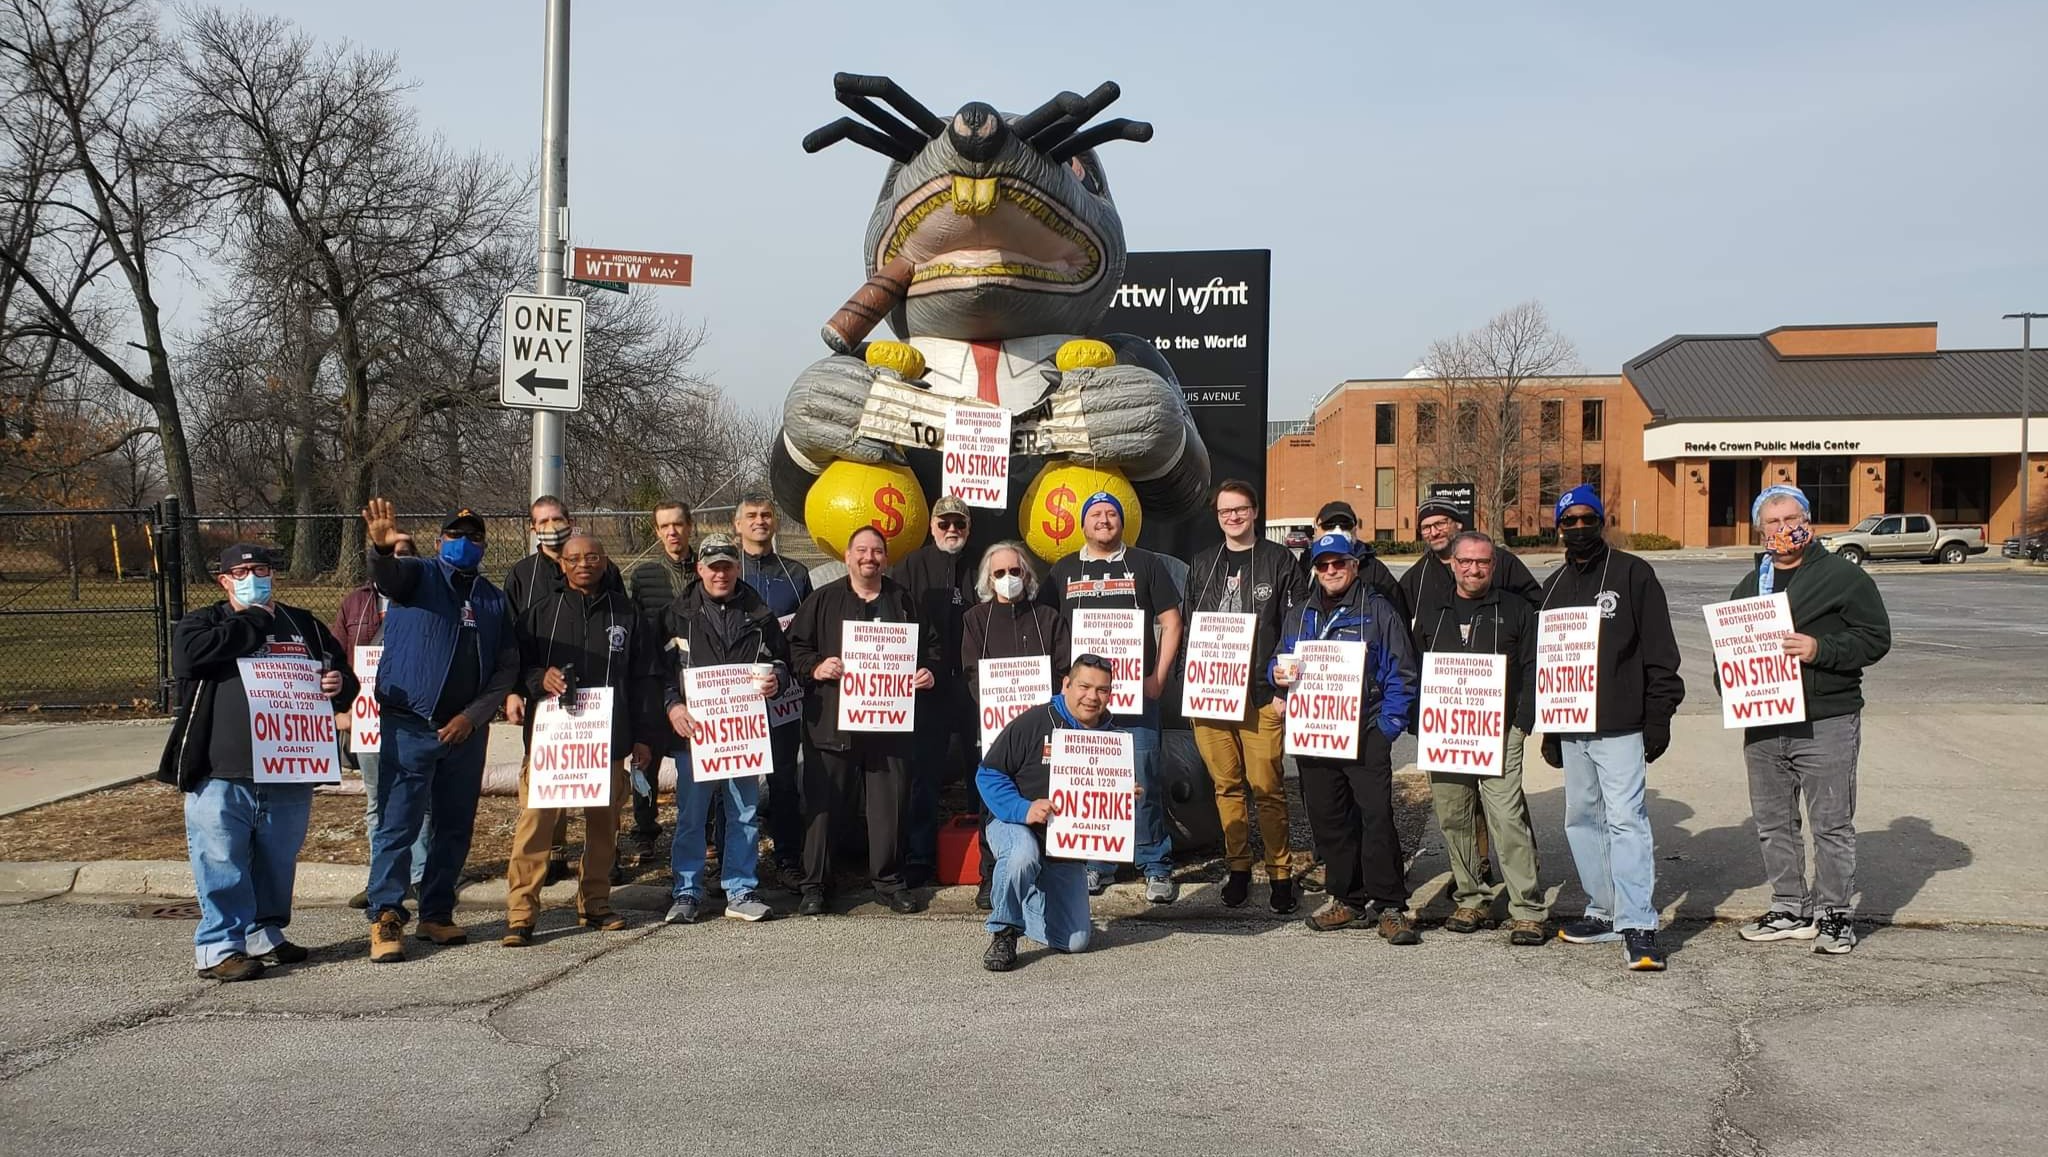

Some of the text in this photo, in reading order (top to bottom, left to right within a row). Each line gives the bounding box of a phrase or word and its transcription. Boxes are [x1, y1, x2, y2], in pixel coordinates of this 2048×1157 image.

[612, 255, 652, 264] HONORARY
[586, 261, 676, 279] WTTW WAY
[1178, 277, 1248, 315] wfmt
[515, 306, 572, 333] ONE
[1155, 335, 1247, 349] to the World
[513, 336, 572, 363] WAY
[1184, 392, 1240, 401] UIS AVENUE
[956, 411, 1002, 420] INTERNATIONAL
[956, 419, 1001, 428] BROTHERHOOD
[911, 422, 937, 446] TO
[947, 435, 1008, 445] ELECTRICAL WORKERS
[1685, 441, 1860, 450] Renée Crown Public Media Center
[959, 443, 994, 452] LOCAL 1220
[946, 452, 1007, 478] ON STRIKE
[950, 486, 1000, 501] WTTW
[1716, 600, 1775, 616] INTERNATIONAL
[1200, 616, 1246, 624] INTERNATIONAL
[1719, 610, 1776, 626] BROTHERHOOD
[854, 626, 908, 635] INTERNATIONAL
[1083, 621, 1133, 629] BROTHERHOOD
[1200, 625, 1244, 633] BROTHERHOOD
[1745, 624, 1754, 633] OF
[855, 635, 906, 643] BROTHERHOOD
[1110, 638, 1141, 646] WORKERS
[1558, 633, 1566, 641] OF
[1715, 635, 1753, 648] ELECTRICAL
[1190, 641, 1250, 651] ELECTRICAL WORKERS
[1565, 642, 1595, 651] WORKERS
[1733, 642, 1777, 655] LOCAL 1220
[845, 652, 915, 662] ELECTRICAL WORKERS
[1201, 650, 1236, 659] LOCAL 1220
[1566, 653, 1580, 661] 1220
[252, 663, 313, 672] INTERNATIONAL
[990, 661, 1040, 670] INTERNATIONAL
[1435, 658, 1493, 668] INTERNATIONAL
[256, 672, 314, 681] BROTHERHOOD
[696, 668, 750, 679] INTERNATIONAL
[990, 669, 1040, 678] BROTHERHOOD
[1188, 660, 1247, 686] ON STRIKE
[1435, 667, 1492, 677] BROTHERHOOD
[1722, 654, 1798, 688] ON STRIKE
[697, 677, 751, 688] BROTHERHOOD
[1326, 673, 1359, 682] WORKERS
[1538, 665, 1594, 694] ON STRIKE
[844, 672, 913, 697] ON STRIKE
[982, 684, 1050, 695] ELECTRICAL WORKERS
[1304, 682, 1343, 691] LOCAL 1220
[250, 690, 290, 699] ELECTRICAL
[1424, 686, 1502, 697] ELECTRICAL WORKERS
[1745, 687, 1780, 697] AGAINST
[269, 700, 314, 710] LOCAL 1220
[690, 694, 763, 708] ELECTRICAL WORKERS
[1190, 696, 1239, 713] WTTW
[1439, 696, 1484, 706] LOCAL 1220
[706, 704, 748, 716] LOCAL 1220
[1289, 694, 1358, 721] ON STRIKE
[1732, 698, 1795, 719] WTTW
[848, 709, 906, 724] WTTW
[984, 706, 1005, 730] ON
[1541, 708, 1588, 724] WTTW
[255, 712, 280, 741] ON
[284, 713, 334, 742] STRIKE
[575, 720, 609, 729] WORKERS
[1423, 707, 1501, 737] ON STRIKE
[576, 731, 592, 739] 1220
[694, 714, 766, 745] ON STRIKE
[1065, 735, 1122, 746] INTERNATIONAL
[1293, 732, 1350, 750] WTTW
[1442, 738, 1479, 746] AGAINST
[714, 744, 749, 753] AGAINST
[1065, 745, 1121, 756] BROTHERHOOD
[534, 743, 608, 771] ON STRIKE
[702, 752, 763, 772] WTTW
[1089, 757, 1099, 765] OF
[1427, 748, 1493, 766] WTTW
[263, 757, 329, 774] WTTW
[1054, 766, 1132, 777] ELECTRICAL WORKERS
[1070, 777, 1116, 787] LOCAL 1220
[538, 783, 601, 799] WTTW
[1053, 789, 1132, 820] ON STRIKE
[1072, 822, 1110, 831] AGAINST
[1056, 832, 1125, 852] WTTW
